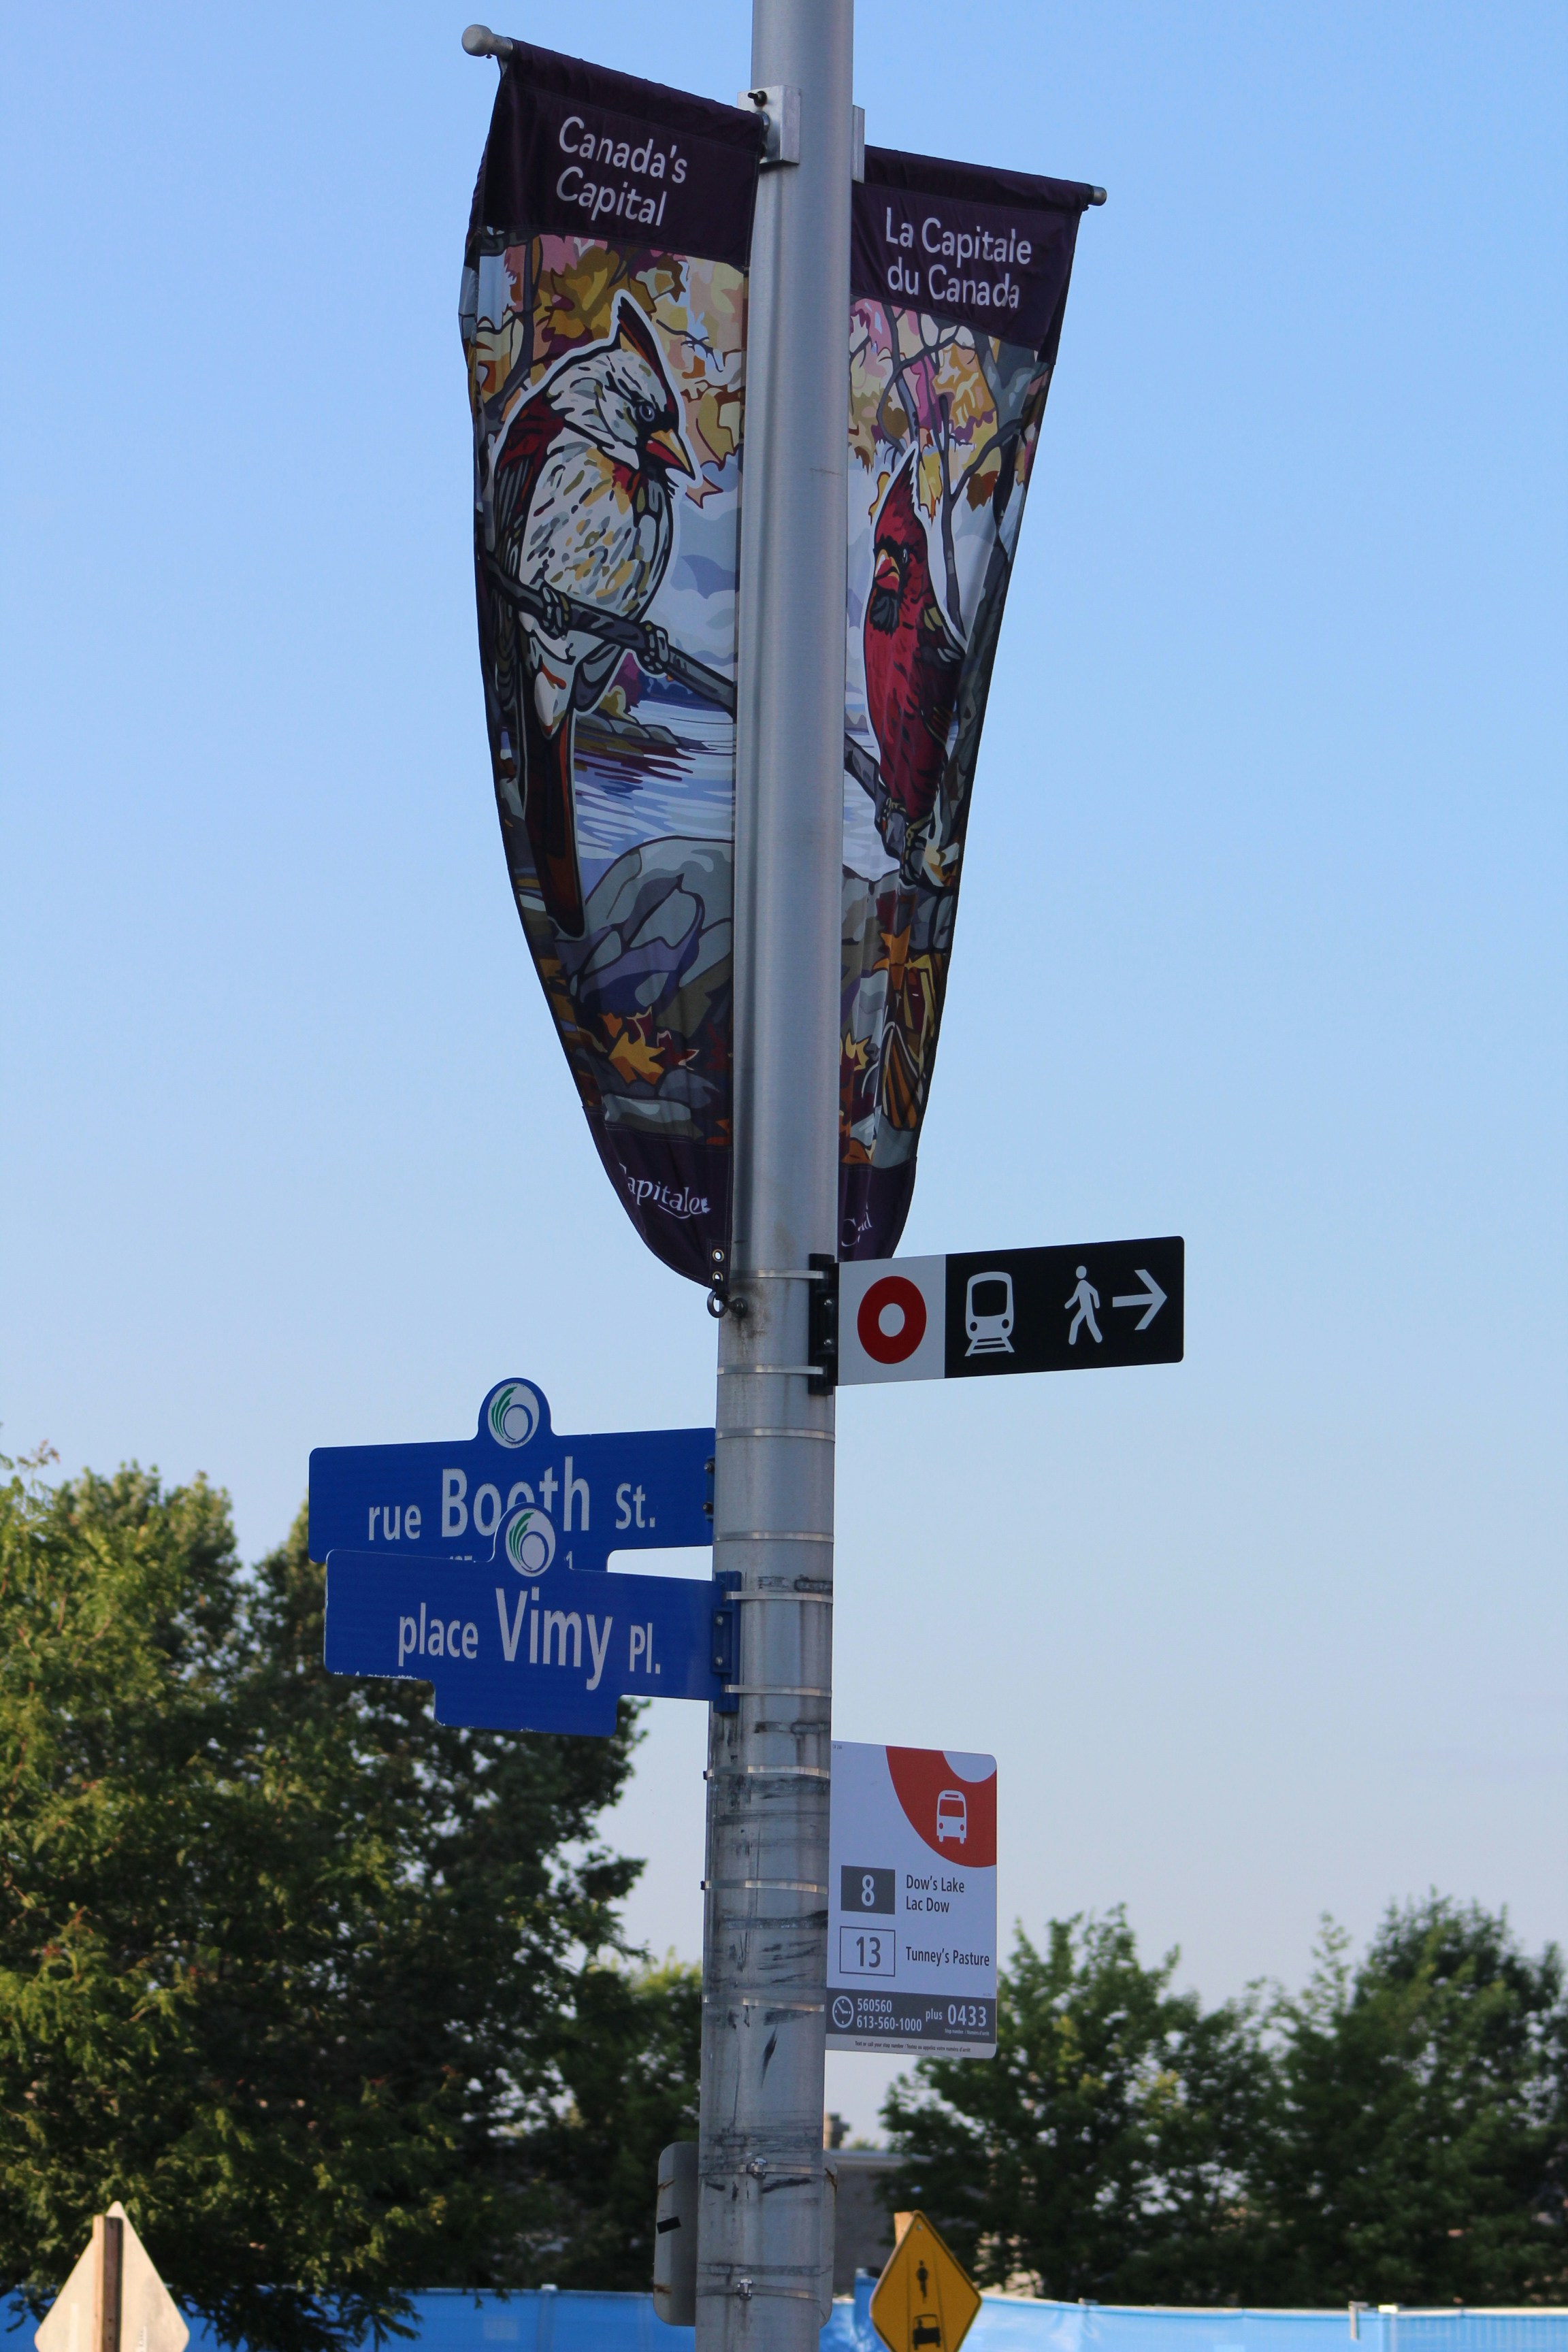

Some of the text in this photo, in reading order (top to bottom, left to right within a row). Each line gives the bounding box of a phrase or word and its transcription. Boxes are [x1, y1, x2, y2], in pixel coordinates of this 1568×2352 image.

[557, 116, 687, 184] Canada's
[556, 165, 667, 226] Capital
[885, 207, 1032, 266] La Capitale
[887, 256, 1020, 309] du Canada
[369, 1505, 421, 1541] rue
[615, 1483, 655, 1530] St.
[398, 1586, 661, 1690] place Vimy Pl.
[861, 1874, 875, 1906] 8
[906, 1874, 965, 1893] Dow's Lake
[906, 1896, 949, 1913] Lac Dow
[855, 1936, 881, 1968] 13
[906, 1946, 990, 1967] Tunney's Pasture
[857, 1998, 987, 2027] 560560 plus 0433
[857, 2015, 922, 2031] 613-560-1000
